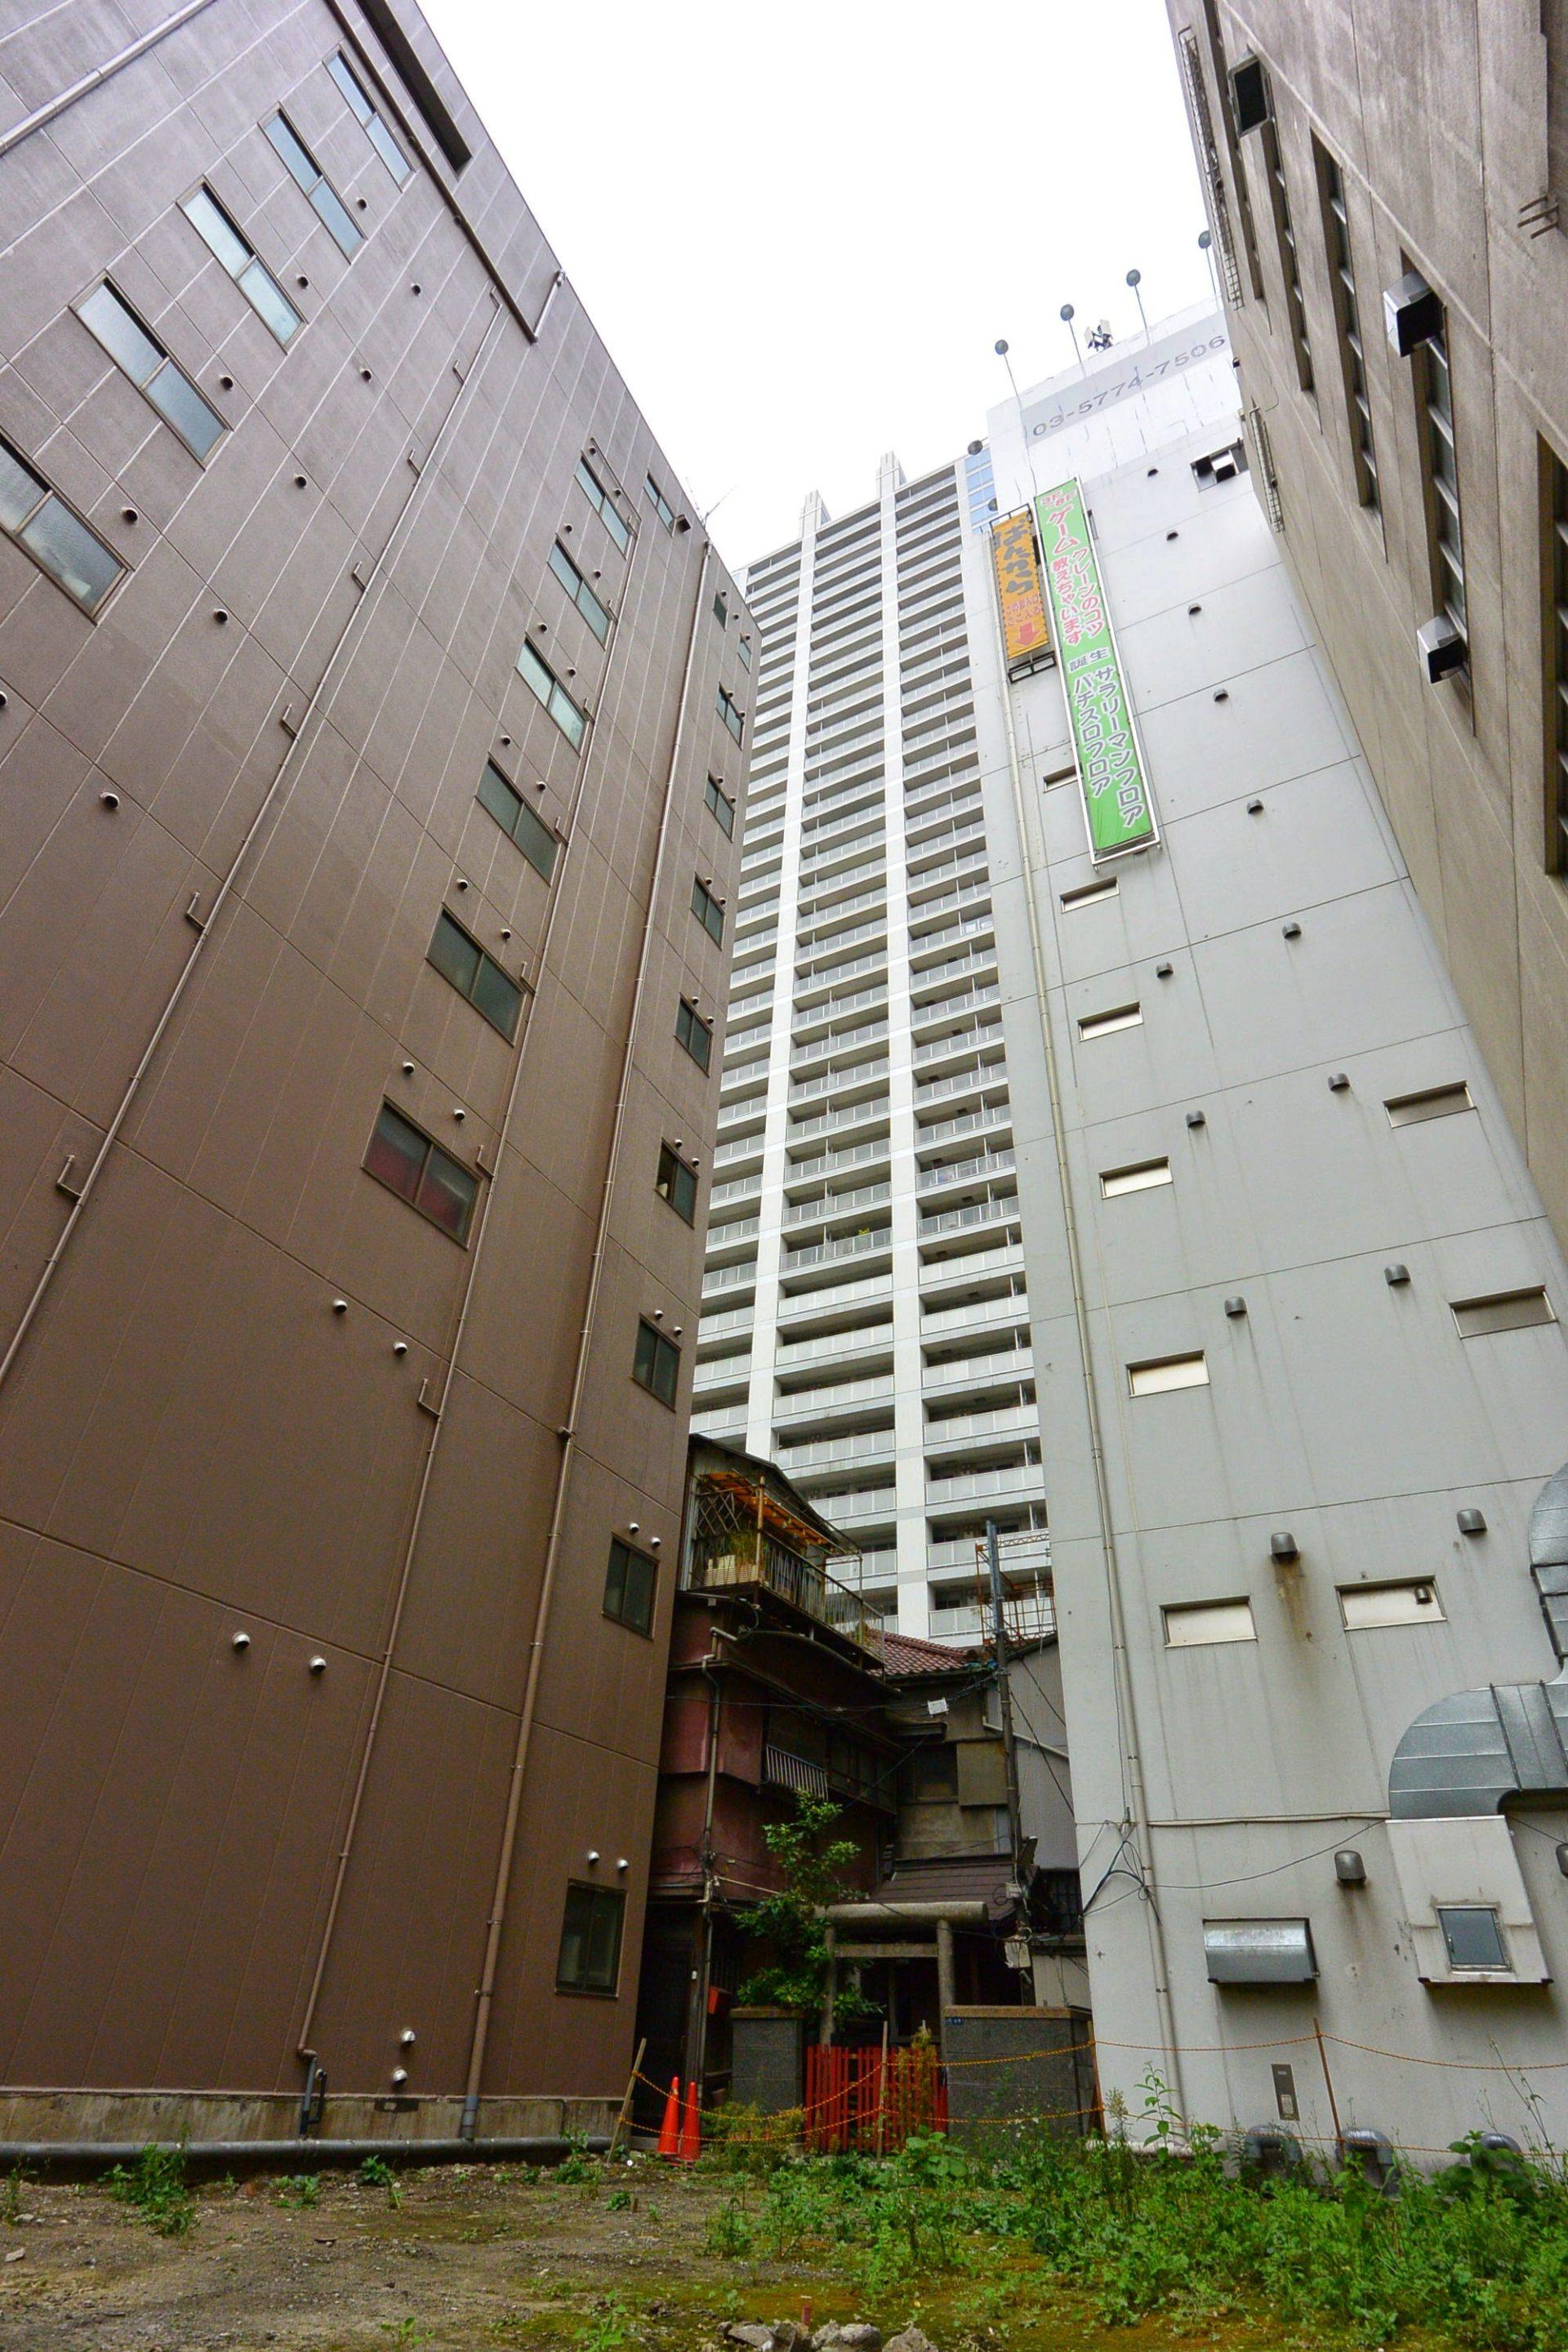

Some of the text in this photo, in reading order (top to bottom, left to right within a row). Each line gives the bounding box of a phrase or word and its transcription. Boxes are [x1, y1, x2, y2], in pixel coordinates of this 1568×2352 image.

[1032, 334, 1226, 436] 03-5774-7506
[1049, 505, 1078, 554] ゲーム
[1053, 556, 1081, 645] 教えちゃいます
[1072, 548, 1103, 637] クレーンのコツ
[1068, 648, 1108, 671] 誕生
[1075, 673, 1111, 798] パチスロフロア
[1095, 666, 1143, 827] サラリーマンフロア
